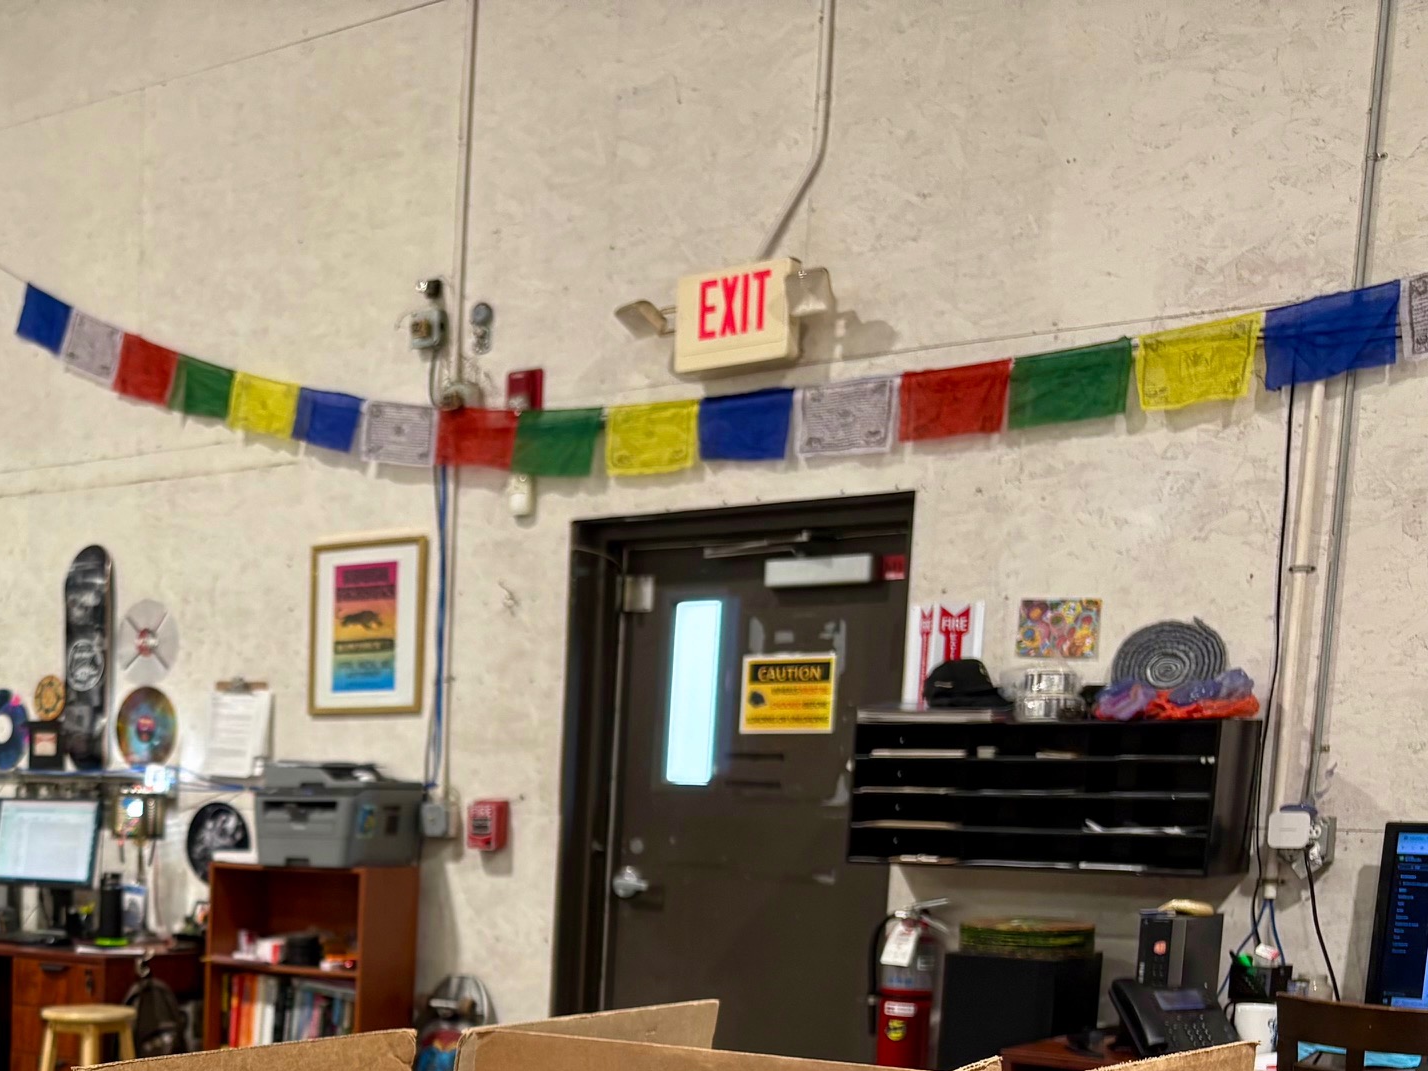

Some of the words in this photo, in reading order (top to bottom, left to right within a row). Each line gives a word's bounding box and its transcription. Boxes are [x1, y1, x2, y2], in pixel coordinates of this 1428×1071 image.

[698, 269, 772, 342] EXIT
[941, 616, 968, 632] FIRE
[757, 665, 822, 682] CAUTION
